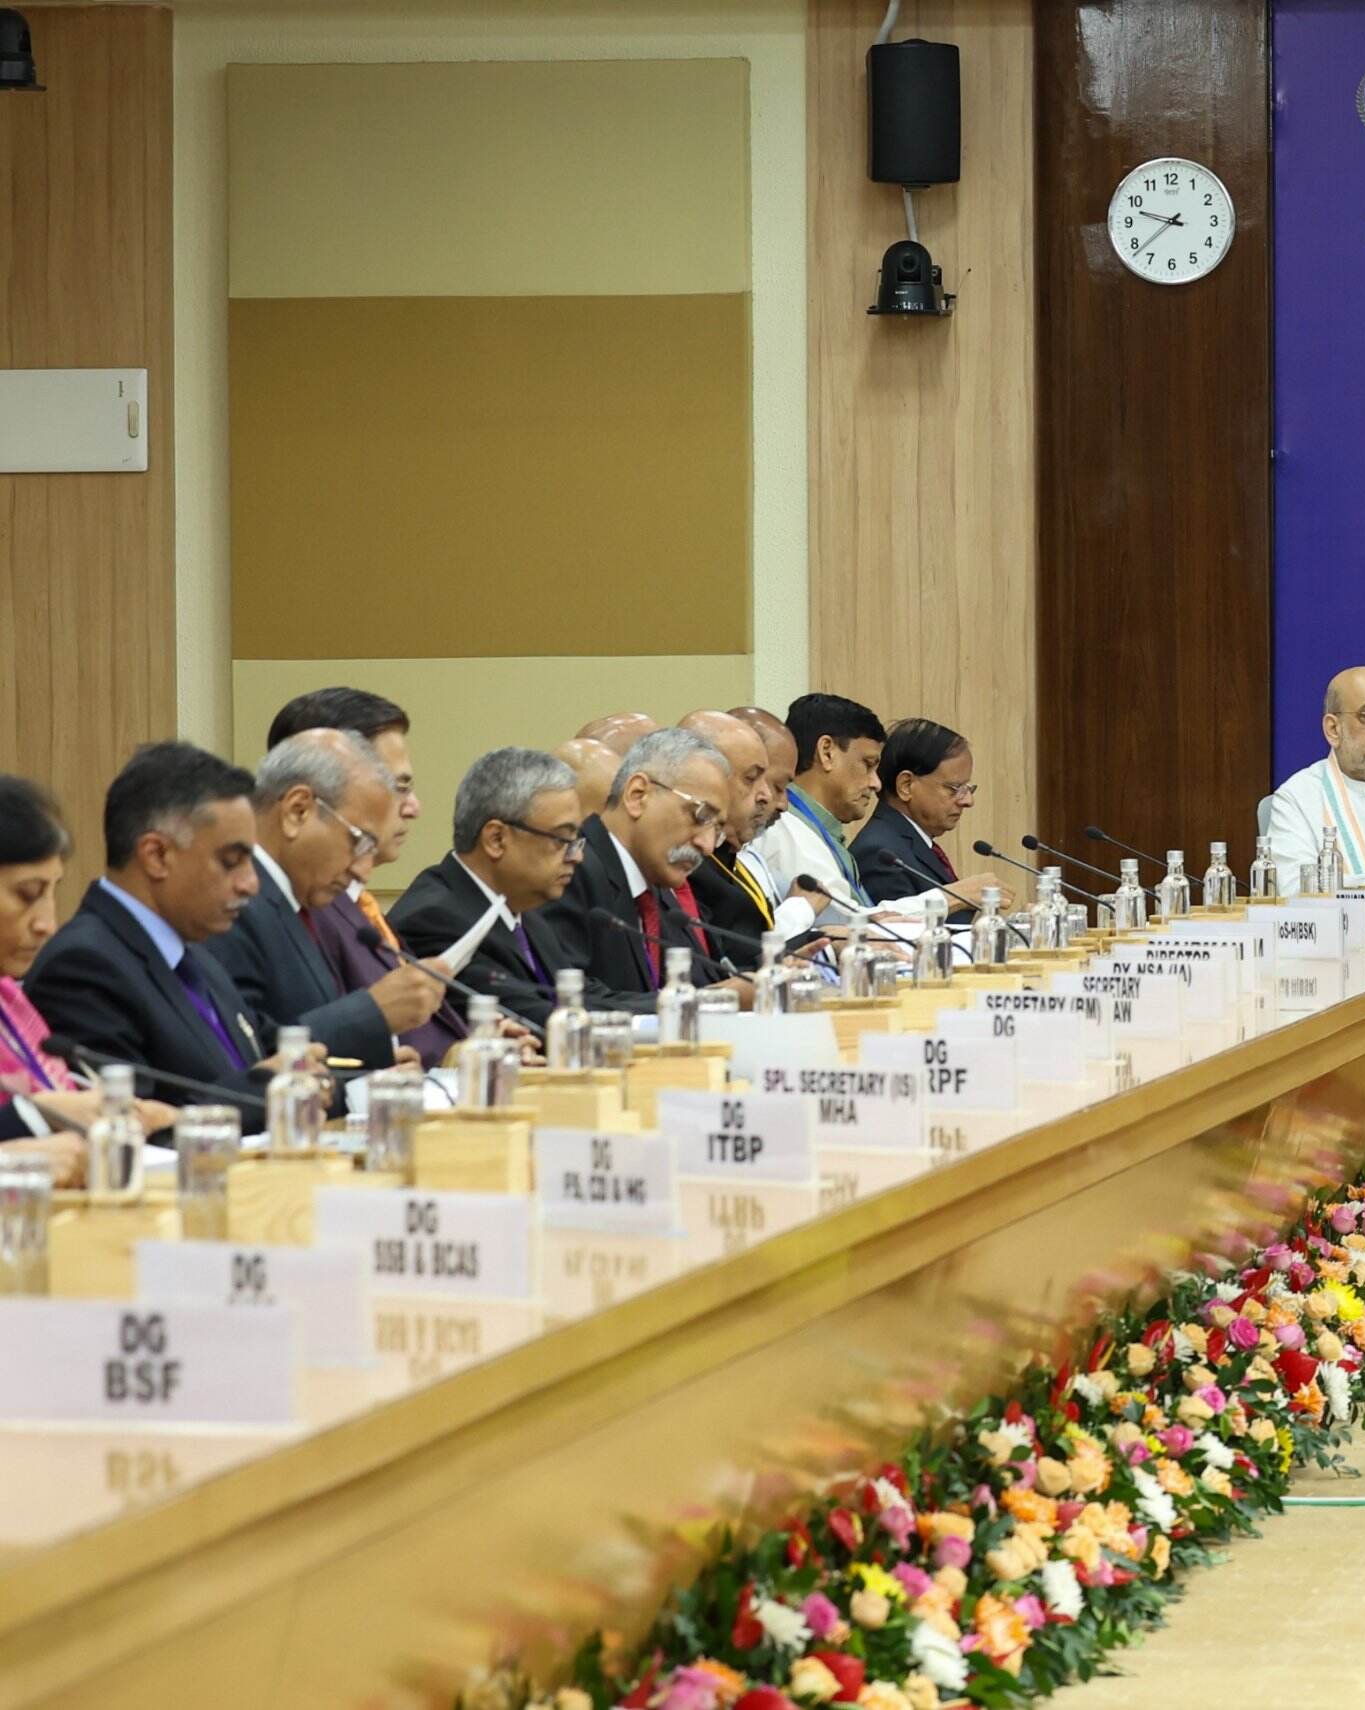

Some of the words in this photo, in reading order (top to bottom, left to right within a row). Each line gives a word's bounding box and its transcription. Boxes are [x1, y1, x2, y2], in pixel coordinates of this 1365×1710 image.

[1144, 179, 1156, 191] 11
[1163, 173, 1178, 185] 12
[1190, 179, 1195, 190] 1
[1128, 195, 1142, 207] 10
[1204, 194, 1212, 206] 2
[1125, 216, 1133, 228] 9
[1210, 215, 1218, 227] 3
[1131, 238, 1139, 250] 8
[1205, 236, 1212, 248] 4
[1146, 253, 1155, 264] 7
[1168, 258, 1176, 270] 6
[1189, 252, 1197, 264] 5
[1278, 921, 1317, 944] oS-H(BSK)
[1083, 976, 1141, 999] SECRETARY
[987, 994, 1067, 1012] SECRETARY
[993, 1014, 1015, 1037] DG
[925, 1039, 947, 1064] DG
[764, 1069, 794, 1093] SPL.
[800, 1069, 885, 1097] SECRETARY
[722, 1101, 745, 1130] DG
[819, 1098, 858, 1125] MHA
[708, 1133, 764, 1163] ITBP
[405, 1200, 440, 1236] DG
[230, 1253, 268, 1292] DG
[119, 1312, 167, 1355] DG
[104, 1360, 181, 1403] BSF
